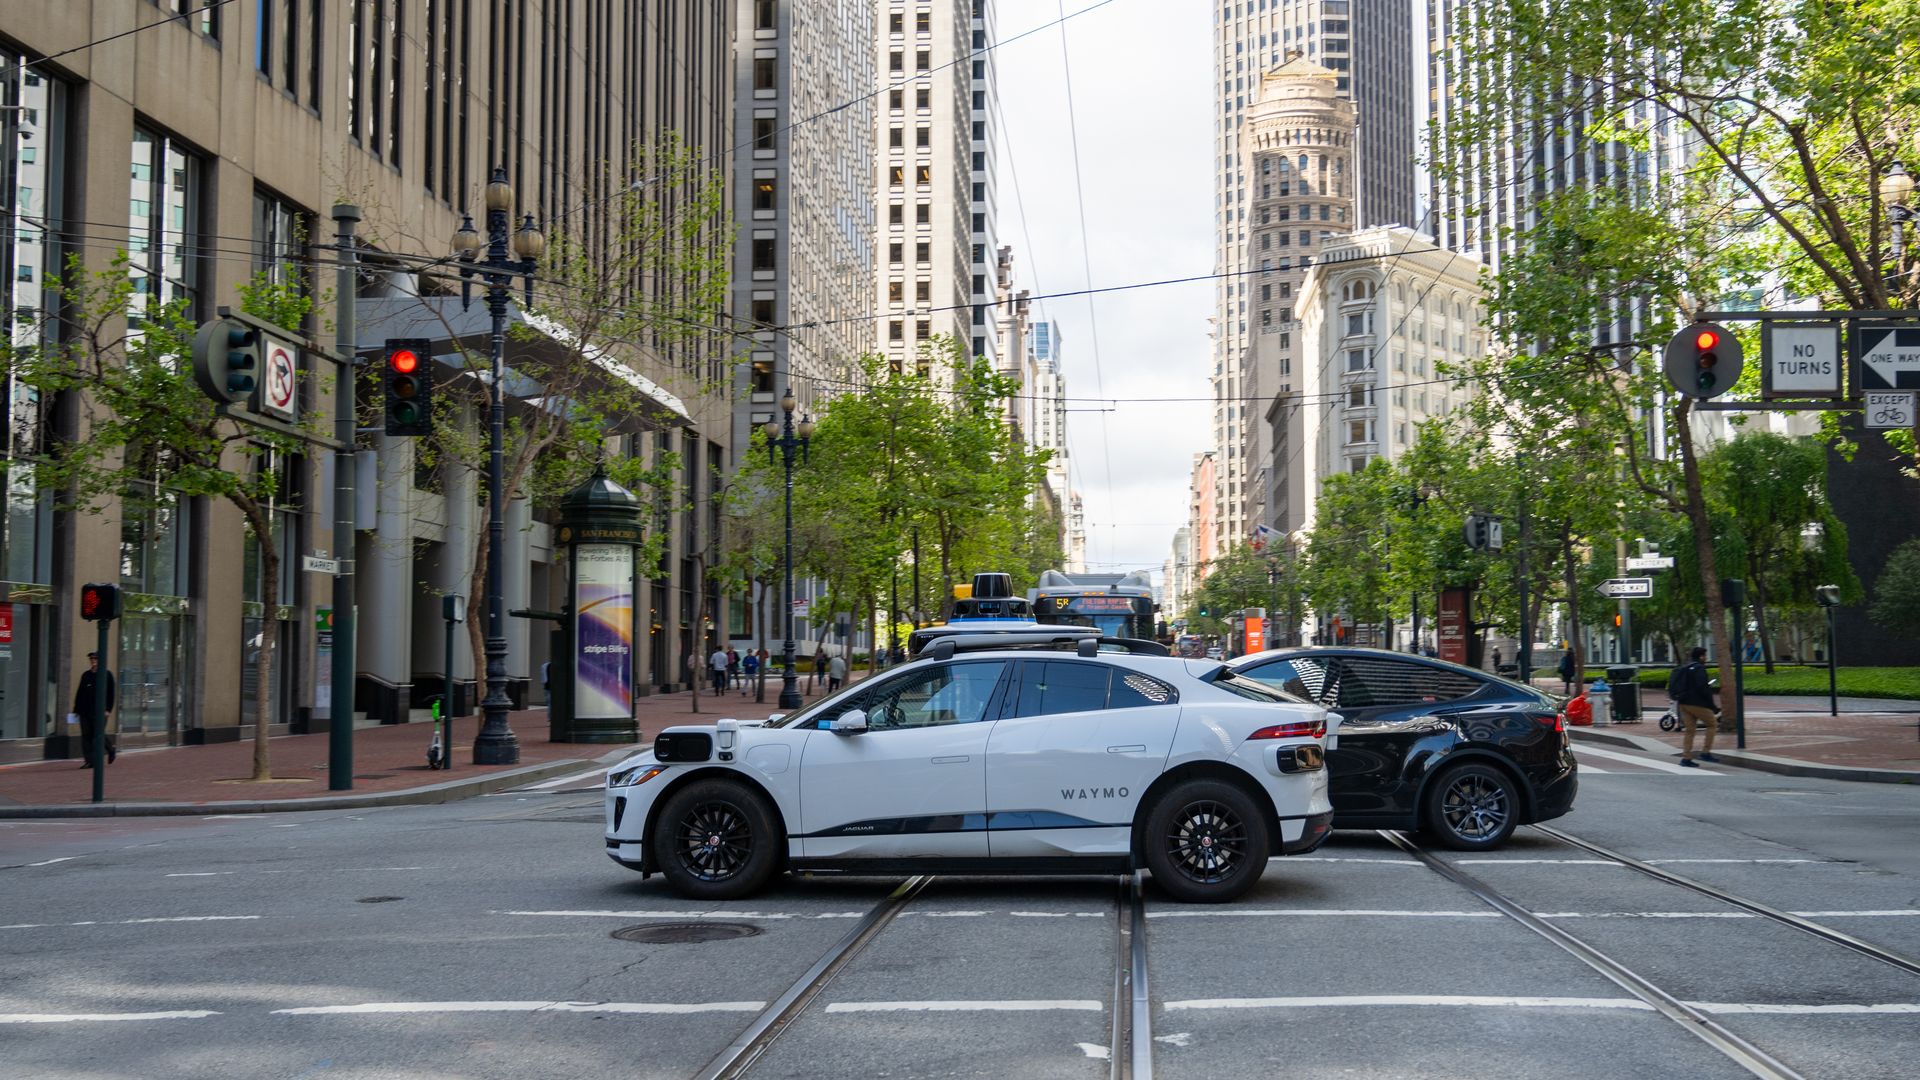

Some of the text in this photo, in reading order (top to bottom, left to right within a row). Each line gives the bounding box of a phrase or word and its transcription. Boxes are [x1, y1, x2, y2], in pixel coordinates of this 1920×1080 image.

[1793, 344, 1815, 358] NO
[1871, 353, 1920, 363] ONE WAY
[1778, 361, 1831, 375] TURNS
[1870, 395, 1911, 405] EXCEPT
[310, 559, 334, 571] MARKET
[1610, 584, 1645, 593] ONE WAY
[1056, 598, 1069, 610] 5R
[584, 644, 629, 655] stripe Billing
[1061, 787, 1129, 800] WAYMO
